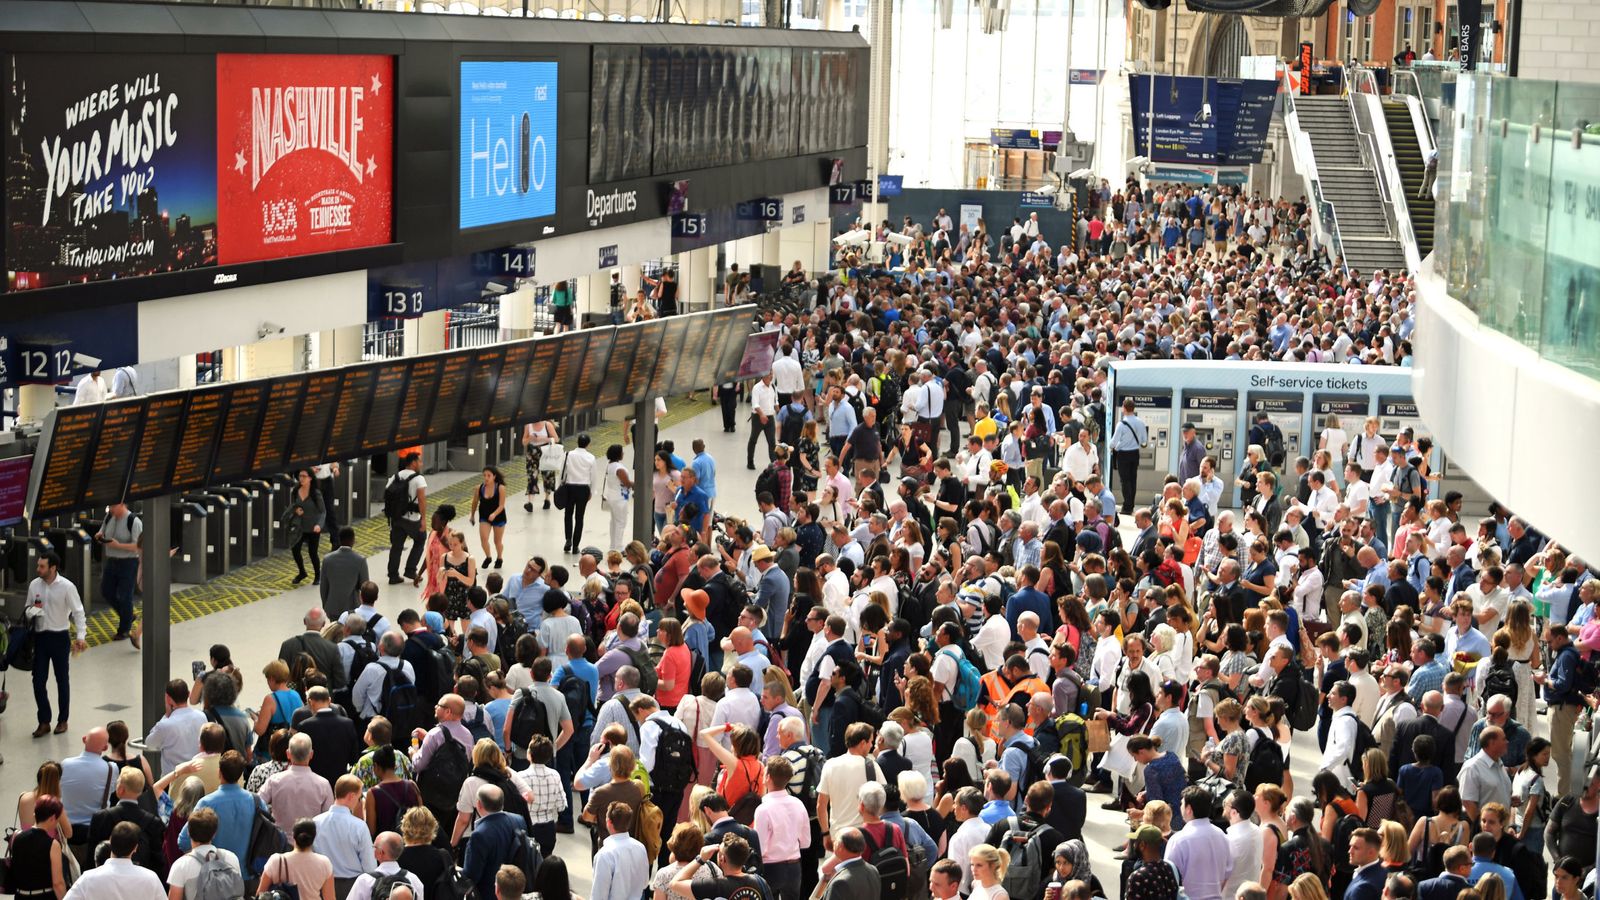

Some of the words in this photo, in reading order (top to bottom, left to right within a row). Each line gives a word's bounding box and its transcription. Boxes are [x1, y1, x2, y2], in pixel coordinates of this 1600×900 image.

[1462, 24, 1470, 51] BARS
[66, 84, 120, 130] WHERE
[124, 73, 161, 106] WILL
[251, 86, 364, 192] NASHVILLE
[41, 134, 102, 228] YOUR
[105, 92, 179, 172] MUSIC
[73, 183, 114, 228] TAKE
[120, 168, 156, 207] YOU?
[835, 188, 850, 201] 17
[860, 183, 873, 196] 18
[262, 198, 298, 236] USA
[310, 204, 353, 230] TENNESSEE
[586, 188, 637, 224] Departures
[760, 202, 776, 217] 16
[681, 218, 697, 234] 15
[502, 253, 524, 272] 14
[527, 253, 535, 272] 14
[385, 292, 407, 313] 13
[412, 291, 423, 313] 13
[21, 350, 48, 378] 12
[55, 349, 71, 376] 12
[1250, 374, 1323, 389] Self-service
[1327, 377, 1368, 390] tickets
